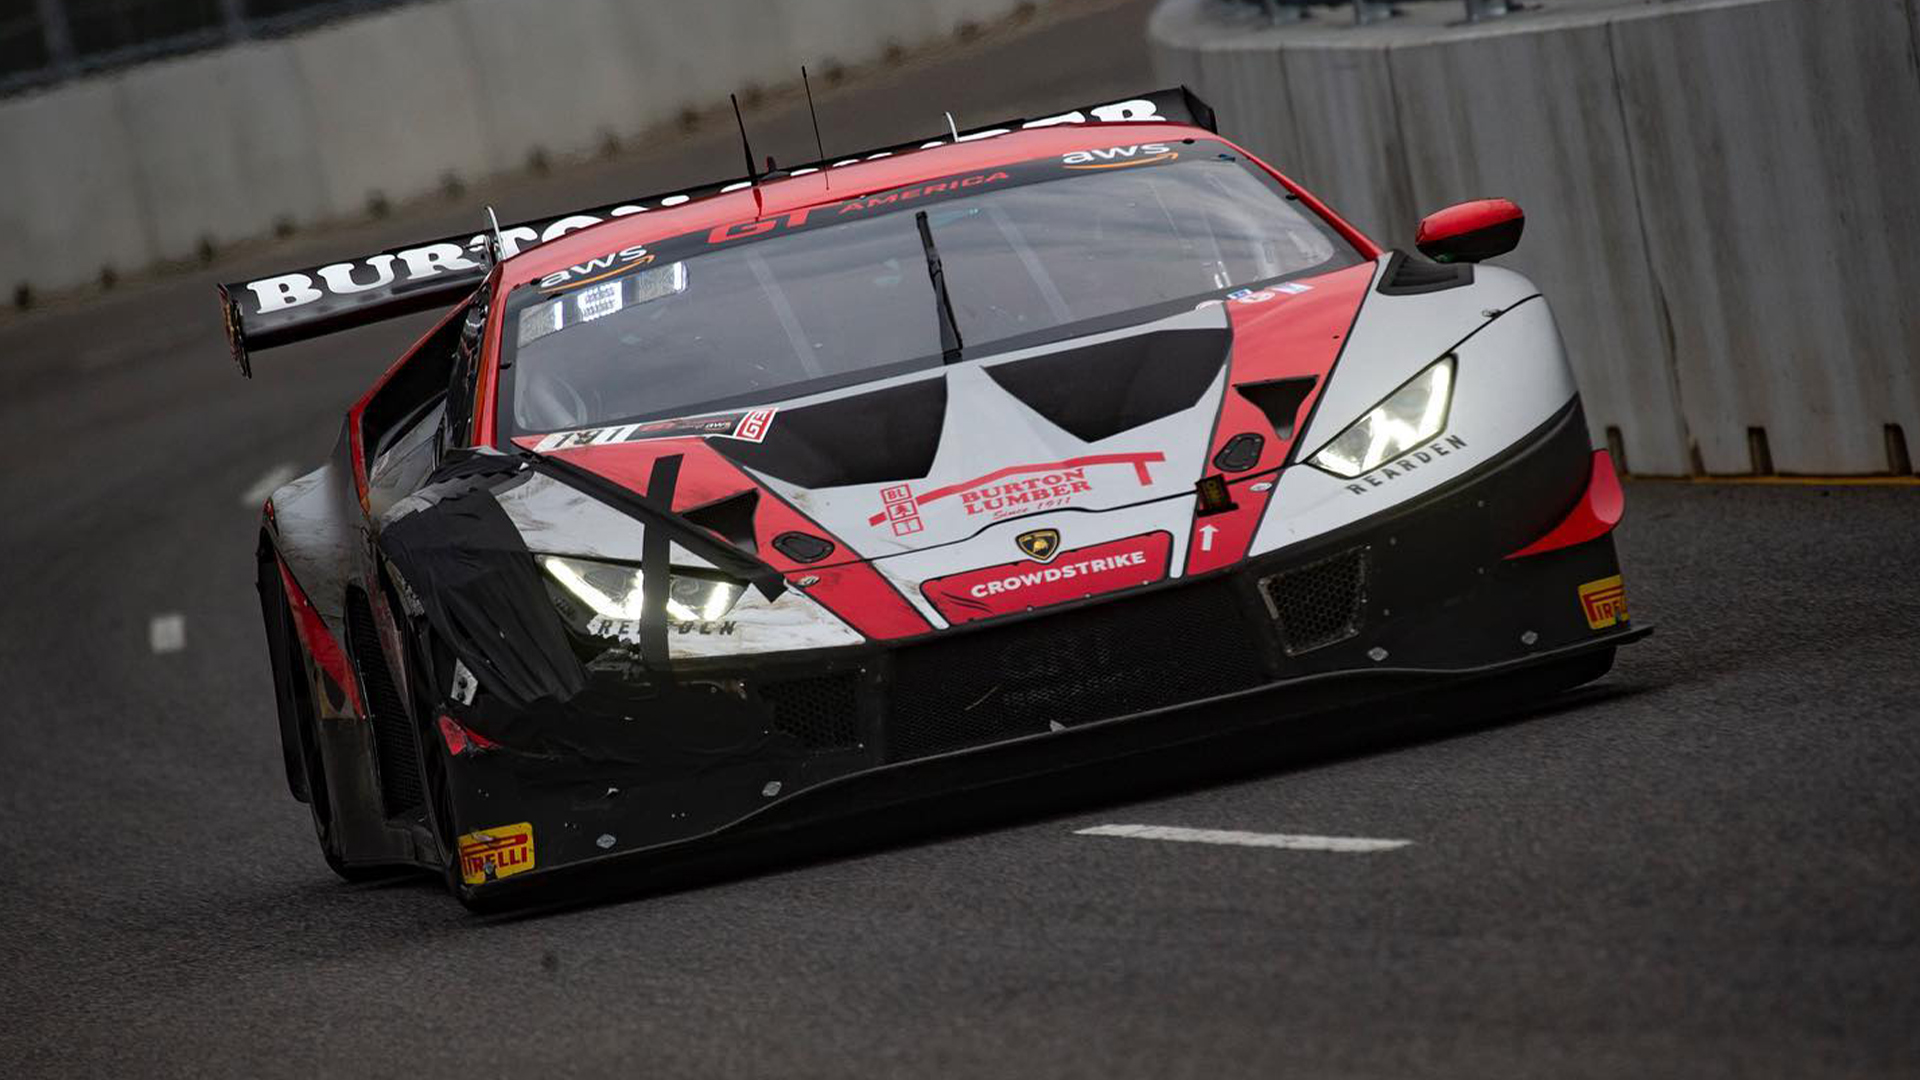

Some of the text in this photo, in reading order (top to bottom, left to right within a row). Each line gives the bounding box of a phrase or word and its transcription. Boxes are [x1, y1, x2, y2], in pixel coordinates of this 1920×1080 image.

[1062, 142, 1170, 165] aws
[708, 172, 1010, 245] GT AMERICA
[541, 244, 648, 289] aws
[1345, 434, 1468, 495] REARDEN
[888, 487, 906, 501] BL
[961, 468, 1087, 504] BURTON
[964, 481, 1093, 516] LUMBER
[971, 551, 1146, 597] CROWDSTRIKE
[597, 619, 737, 635] REDEN
